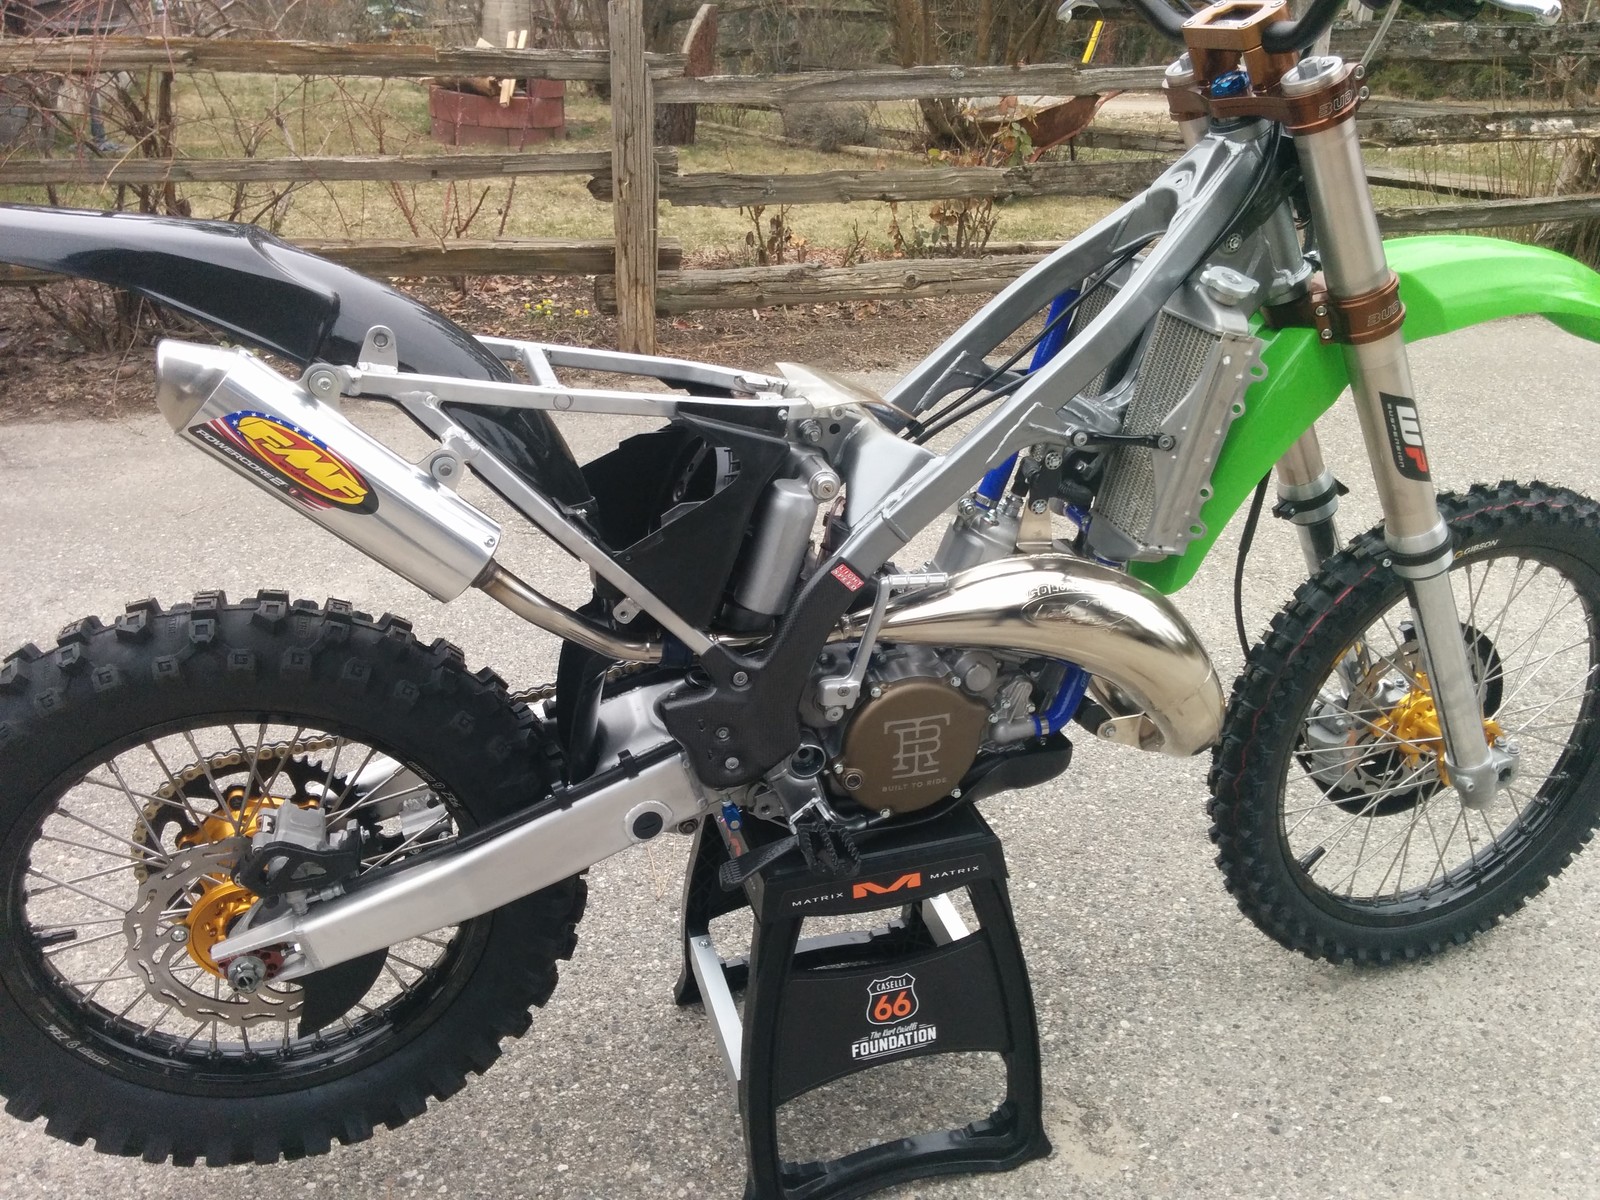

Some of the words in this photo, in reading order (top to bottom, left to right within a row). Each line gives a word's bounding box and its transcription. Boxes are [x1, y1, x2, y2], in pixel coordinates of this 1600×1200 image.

[1396, 405, 1429, 473] WP
[237, 420, 368, 498] FMF
[1463, 539, 1499, 555] GIBSON
[881, 783, 909, 792] BUILT
[926, 777, 947, 786] RIDE
[791, 892, 844, 907] MATRIX
[929, 865, 980, 880] MATRIX
[876, 978, 906, 991] CASELLI
[874, 991, 911, 1021] 66
[851, 1026, 937, 1058] FOUNDATION
[870, 1031, 882, 1040] The
[882, 1027, 896, 1037] Kurt
